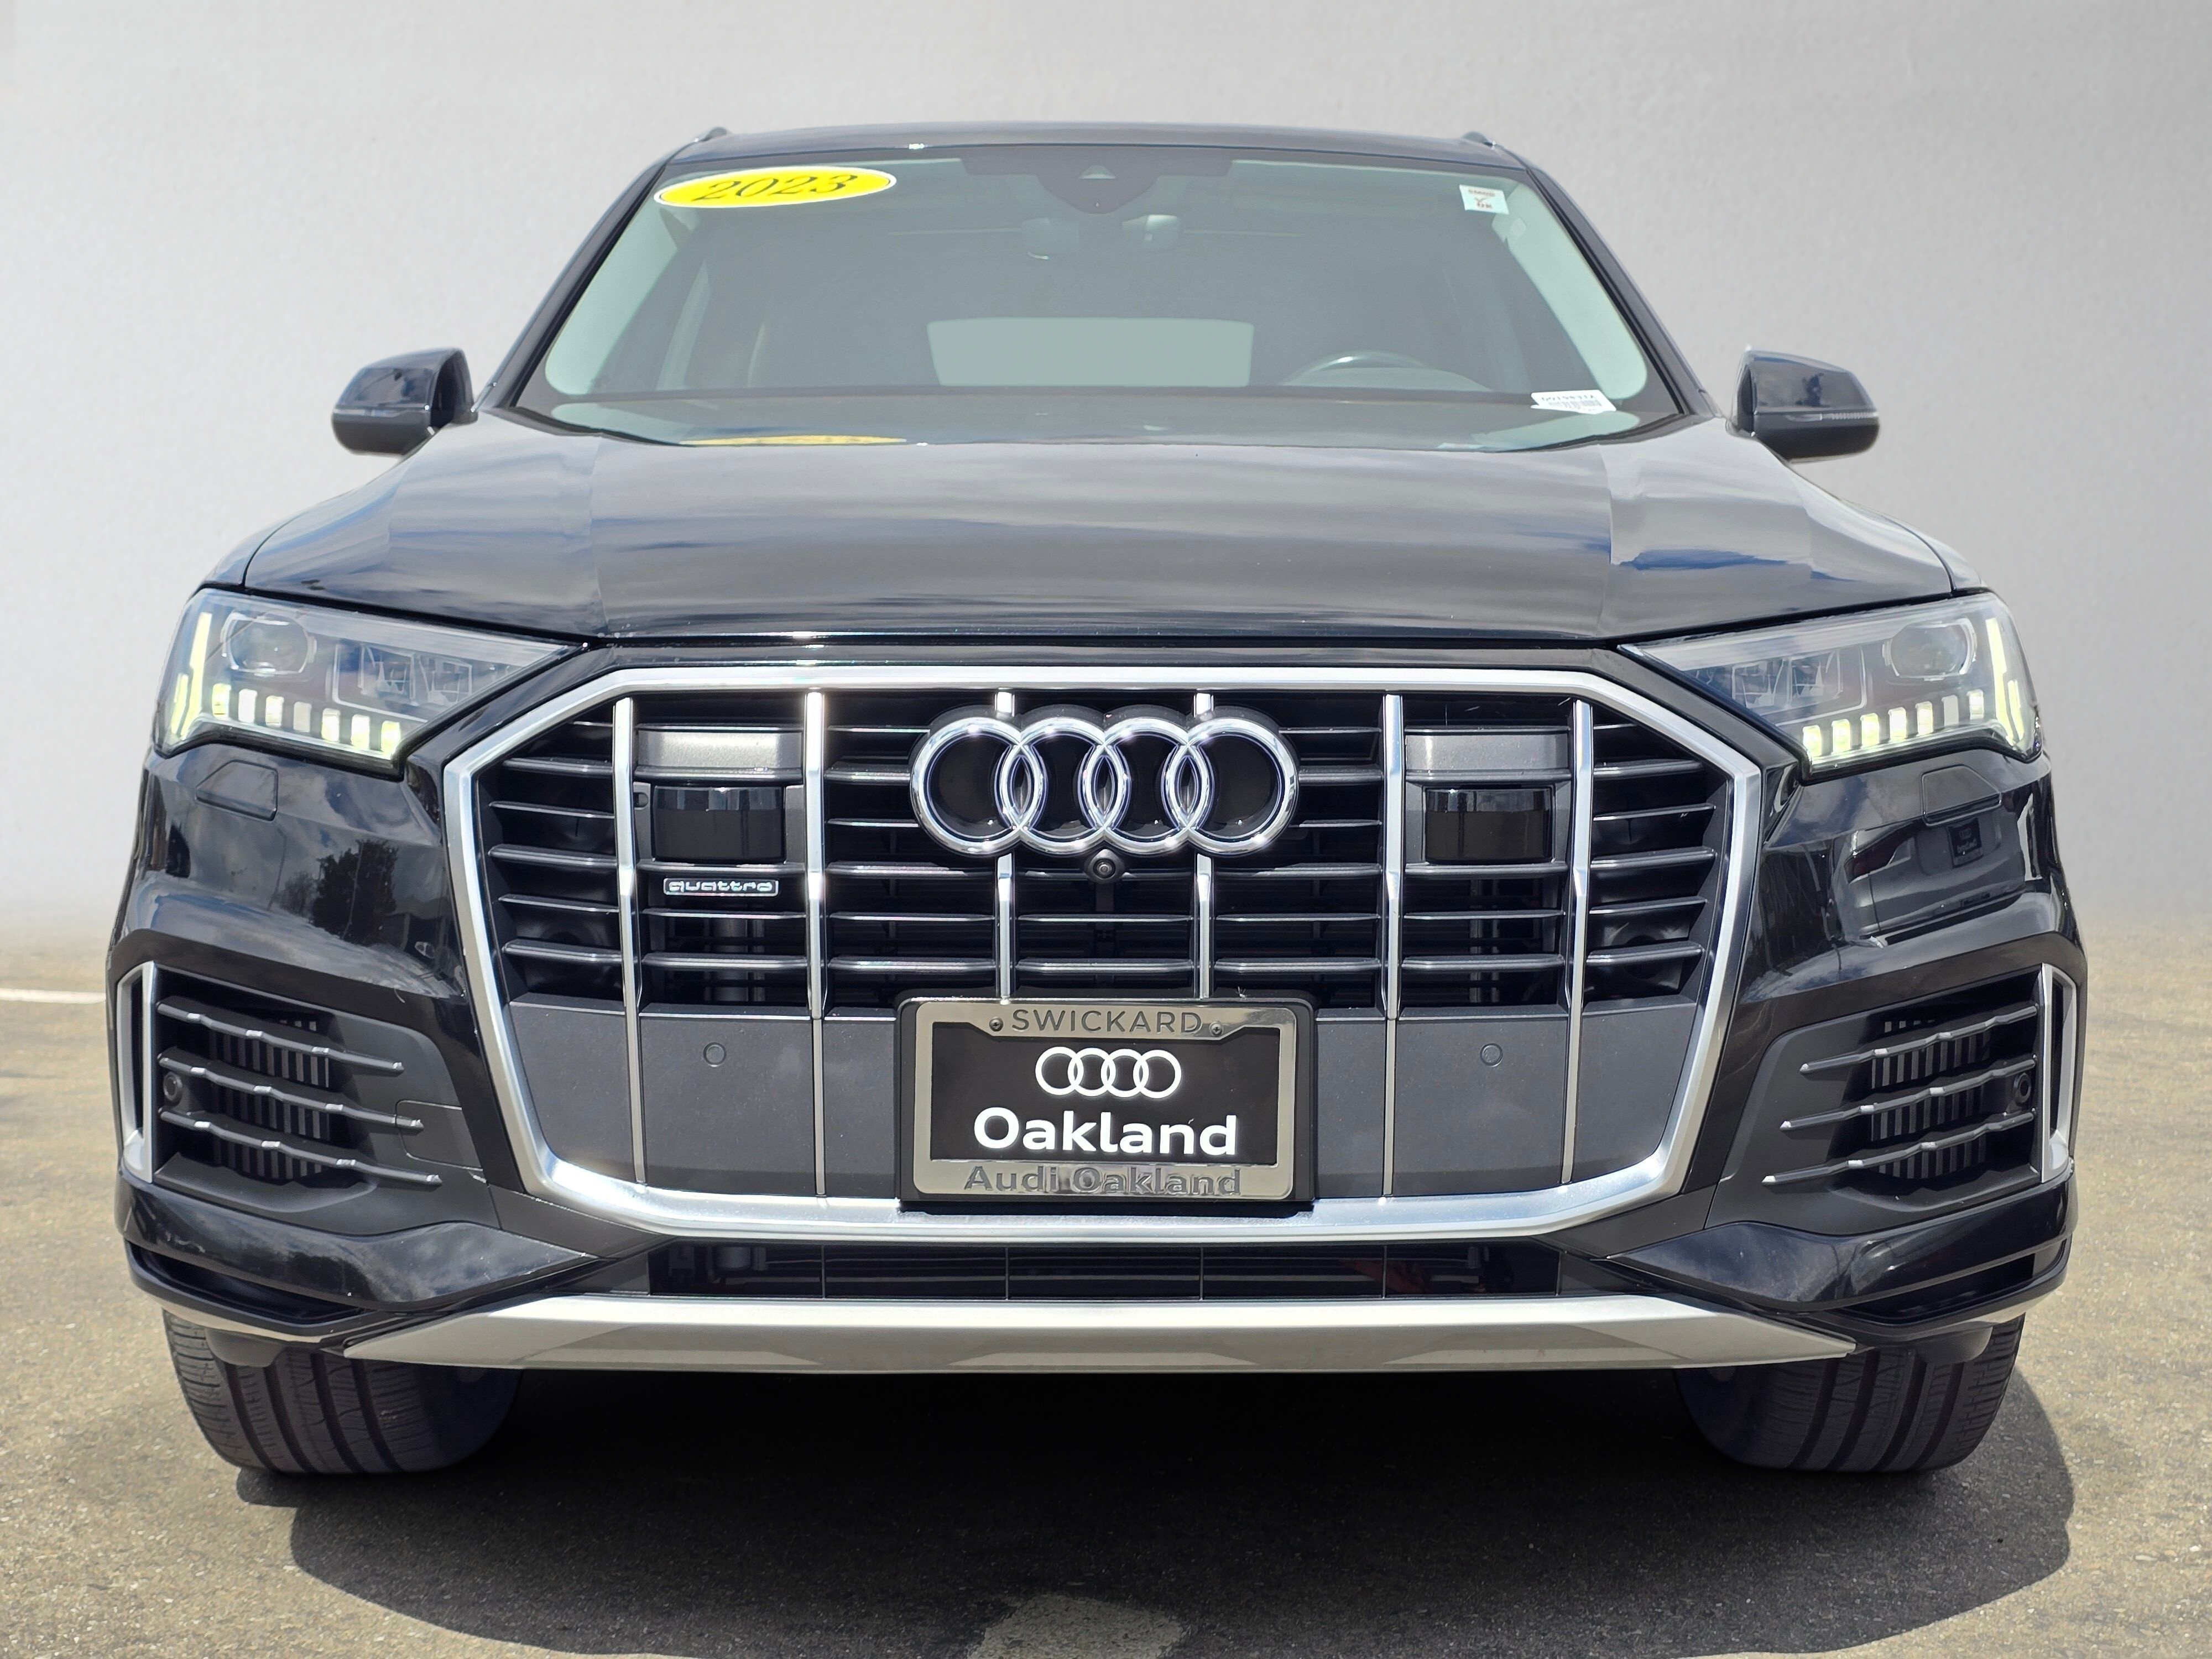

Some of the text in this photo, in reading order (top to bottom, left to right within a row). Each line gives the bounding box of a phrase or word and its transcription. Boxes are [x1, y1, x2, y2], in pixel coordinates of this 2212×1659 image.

[692, 175, 857, 201] 2023
[669, 881, 773, 893] quattro
[1012, 1009, 1202, 1034] SWICKARD
[974, 1107, 1237, 1155] Oakland
[964, 1166, 1241, 1196] Audi Oakland
